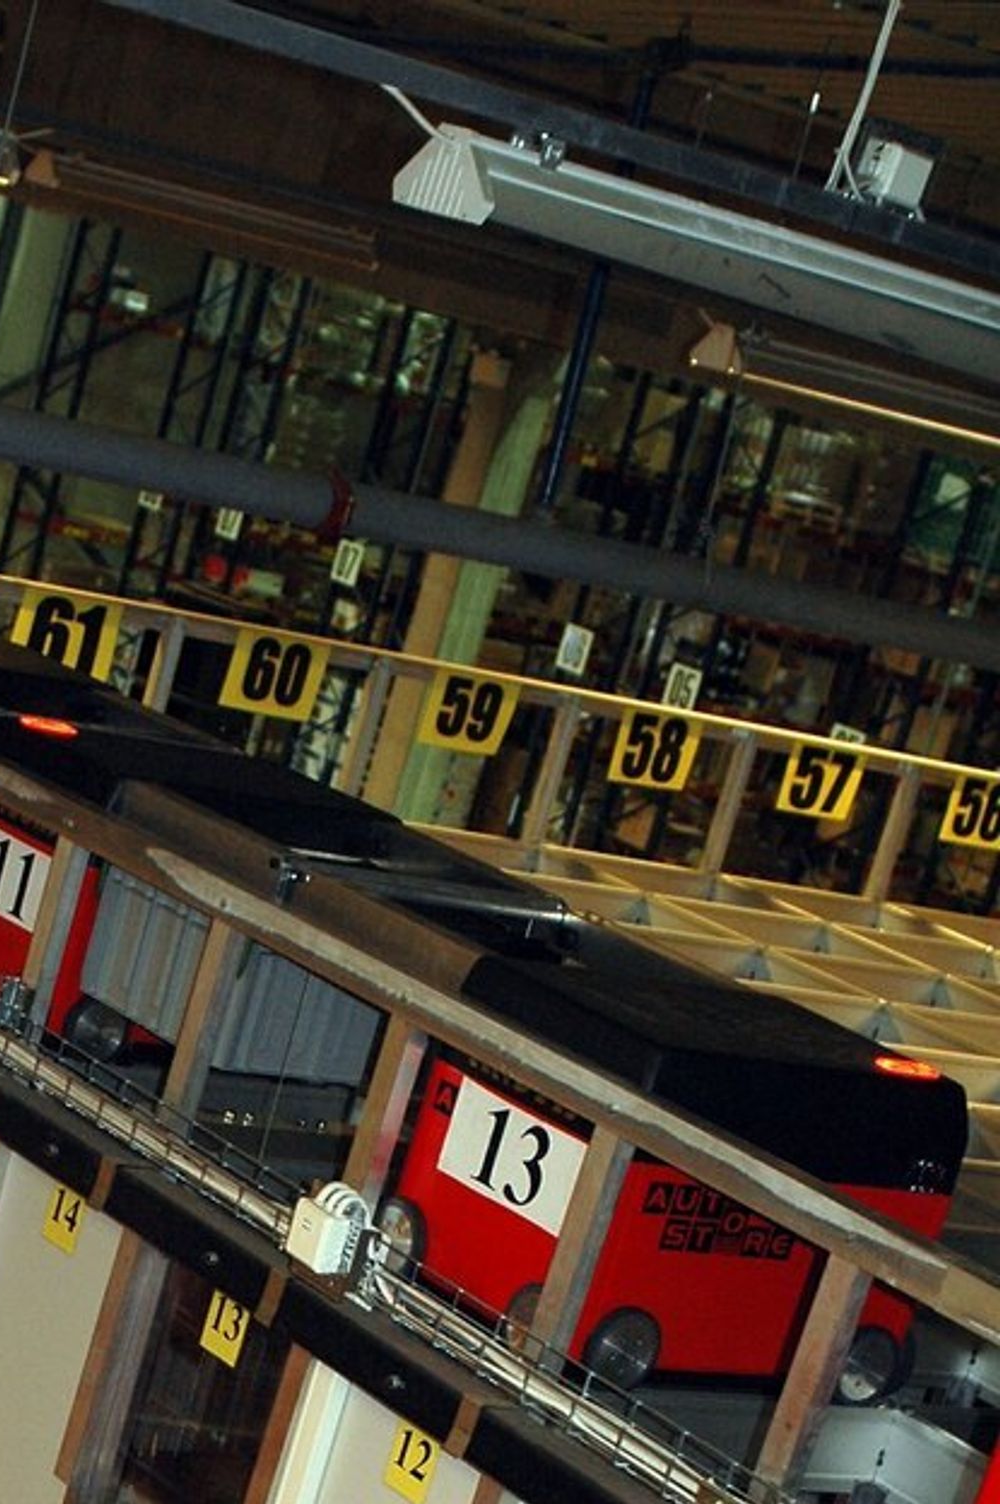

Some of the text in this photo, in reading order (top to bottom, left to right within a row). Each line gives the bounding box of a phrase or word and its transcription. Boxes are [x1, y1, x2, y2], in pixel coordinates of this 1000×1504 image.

[27, 596, 107, 674] 61
[241, 637, 312, 706] 60
[436, 676, 504, 742] 59
[621, 712, 688, 782] 58
[789, 747, 857, 812] 57
[470, 1109, 551, 1206] 13
[52, 1189, 81, 1233] 14
[211, 1297, 243, 1341] 13
[395, 1430, 432, 1482] 12
